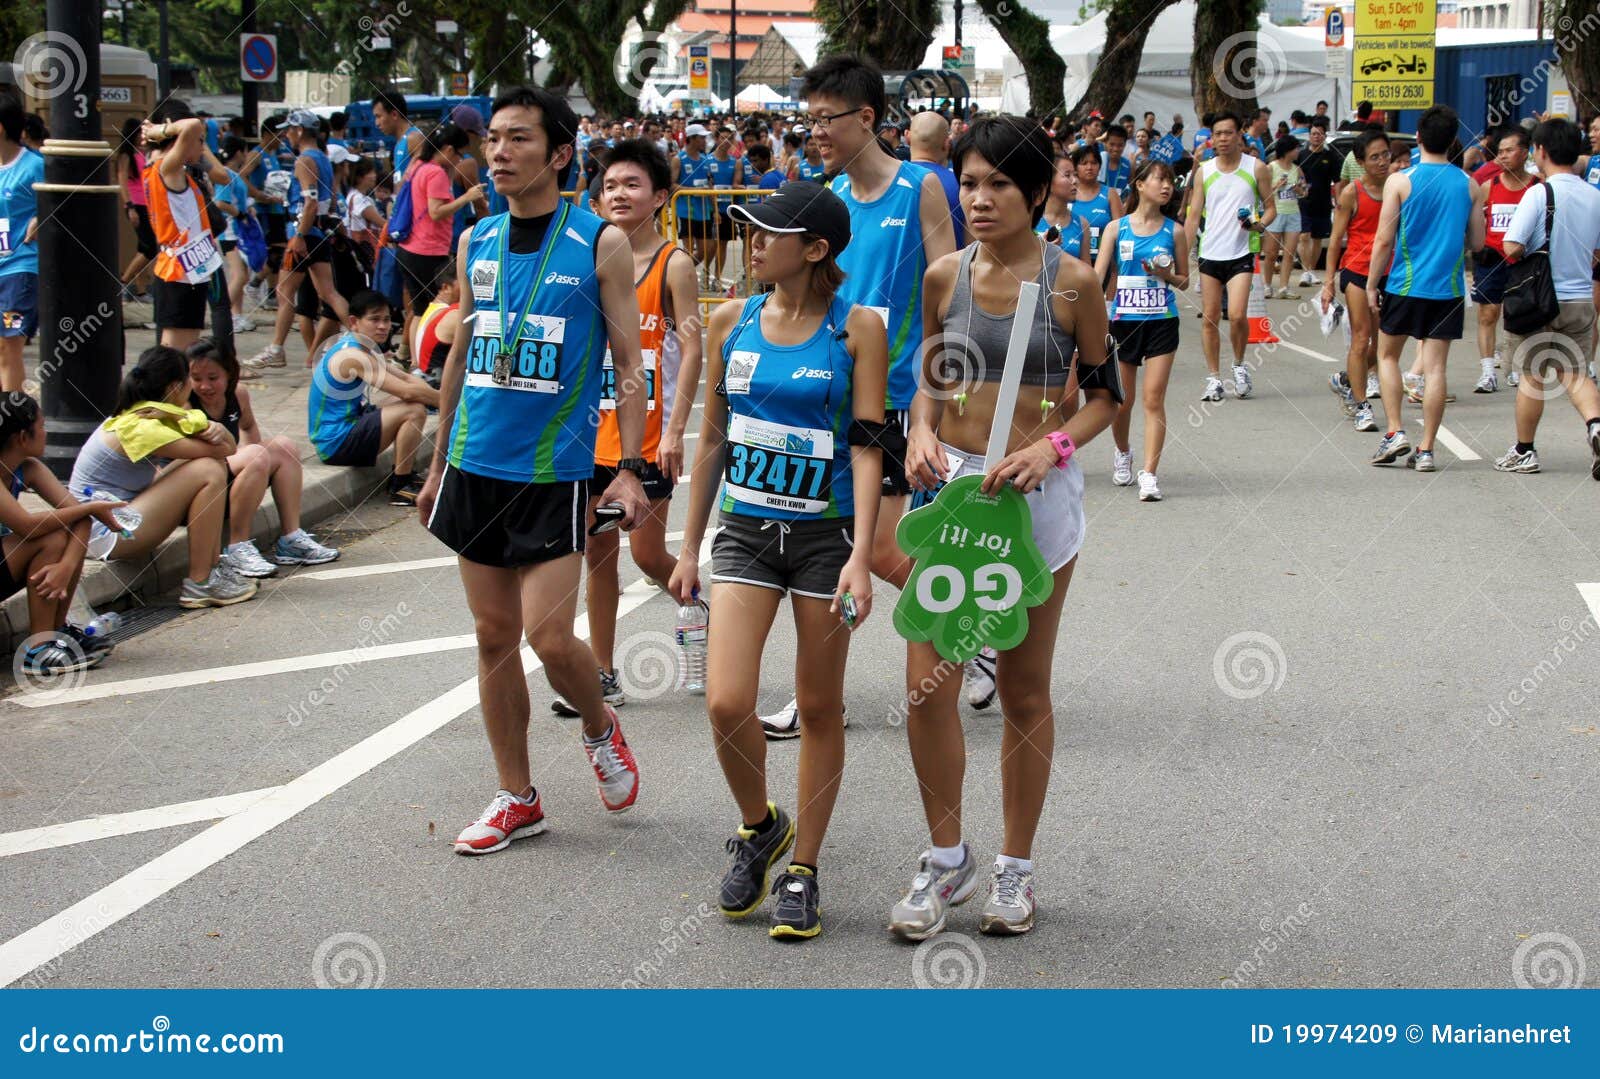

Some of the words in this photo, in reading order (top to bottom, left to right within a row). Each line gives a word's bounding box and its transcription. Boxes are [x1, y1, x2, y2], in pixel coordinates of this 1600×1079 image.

[1368, 3, 1386, 16] Sun,
[1388, 3, 1394, 14] 5
[1398, 17, 1416, 31] 4pm
[1388, 39, 1399, 49] will
[1401, 39, 1409, 48] be
[1363, 86, 1377, 98] Tel:
[1380, 86, 1400, 98] 6319
[1403, 86, 1424, 98] 2630
[74, 94, 88, 118] 3
[0, 232, 9, 250] 1
[1118, 288, 1166, 307] 124536
[472, 337, 558, 379] 3068
[523, 381, 537, 389] SENG
[730, 445, 826, 498] 32477
[766, 496, 787, 507] CHERYL
[788, 499, 807, 509] KWOK
[939, 523, 969, 548] it!
[974, 532, 1012, 558] for
[916, 562, 1023, 613] GO
